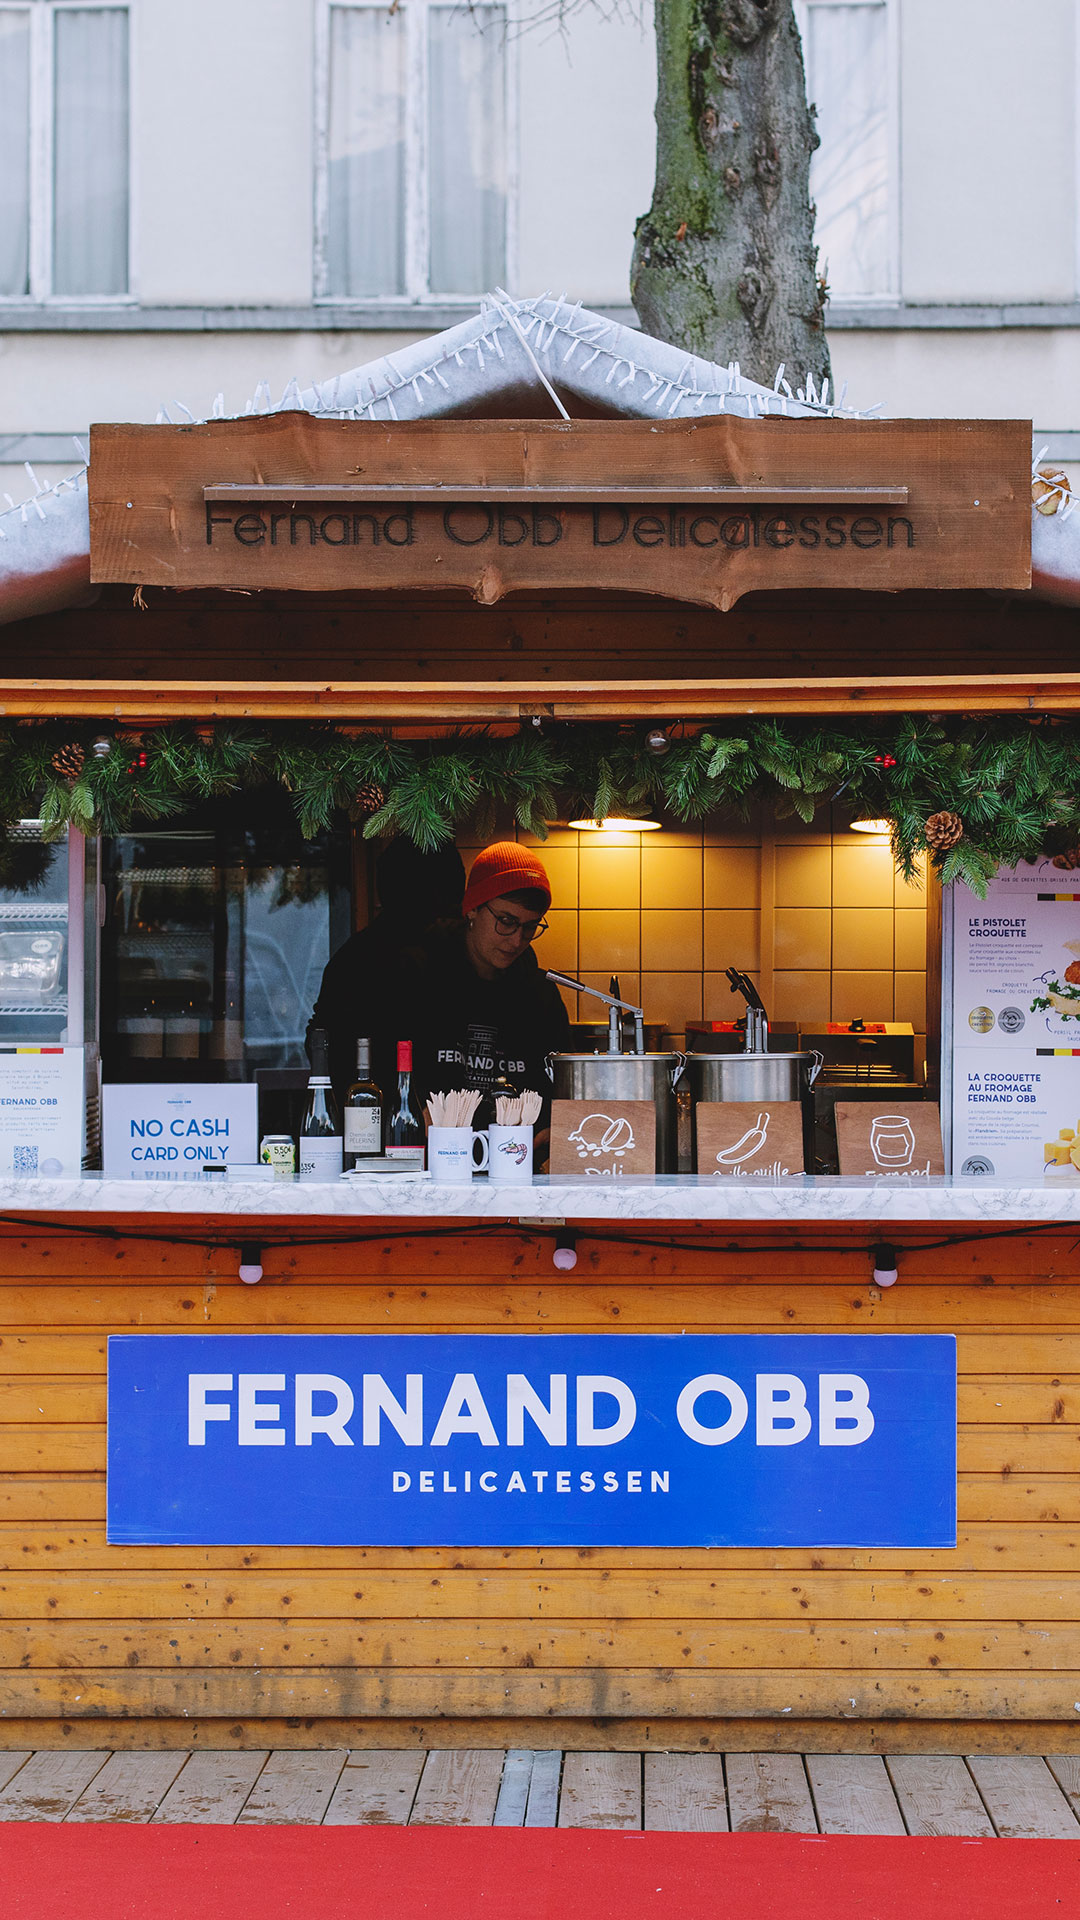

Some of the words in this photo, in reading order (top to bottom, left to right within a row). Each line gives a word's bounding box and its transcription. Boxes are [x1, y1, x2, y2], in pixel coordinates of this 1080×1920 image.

[205, 500, 414, 546] Fernand
[443, 501, 563, 547] Obb
[592, 502, 916, 548] Delicatessen
[969, 919, 979, 927] LE
[983, 919, 1027, 927] PISTOLET
[969, 929, 1027, 938] CROQUETTE
[968, 1084, 981, 1092] AU
[985, 1084, 1033, 1092] FROMAGE
[0, 1098, 36, 1106] ERNAND
[40, 1098, 58, 1106] OBB
[968, 1095, 1013, 1103] FERNAND
[1016, 1095, 1037, 1103] OBB
[131, 1120, 163, 1137] NO
[170, 1119, 230, 1137] CASH
[131, 1146, 179, 1161] CARD
[184, 1146, 230, 1160] ONLY
[189, 1374, 637, 1446] FERNAND
[677, 1374, 875, 1446] OBB
[393, 1471, 670, 1493] DELICATESSEN
